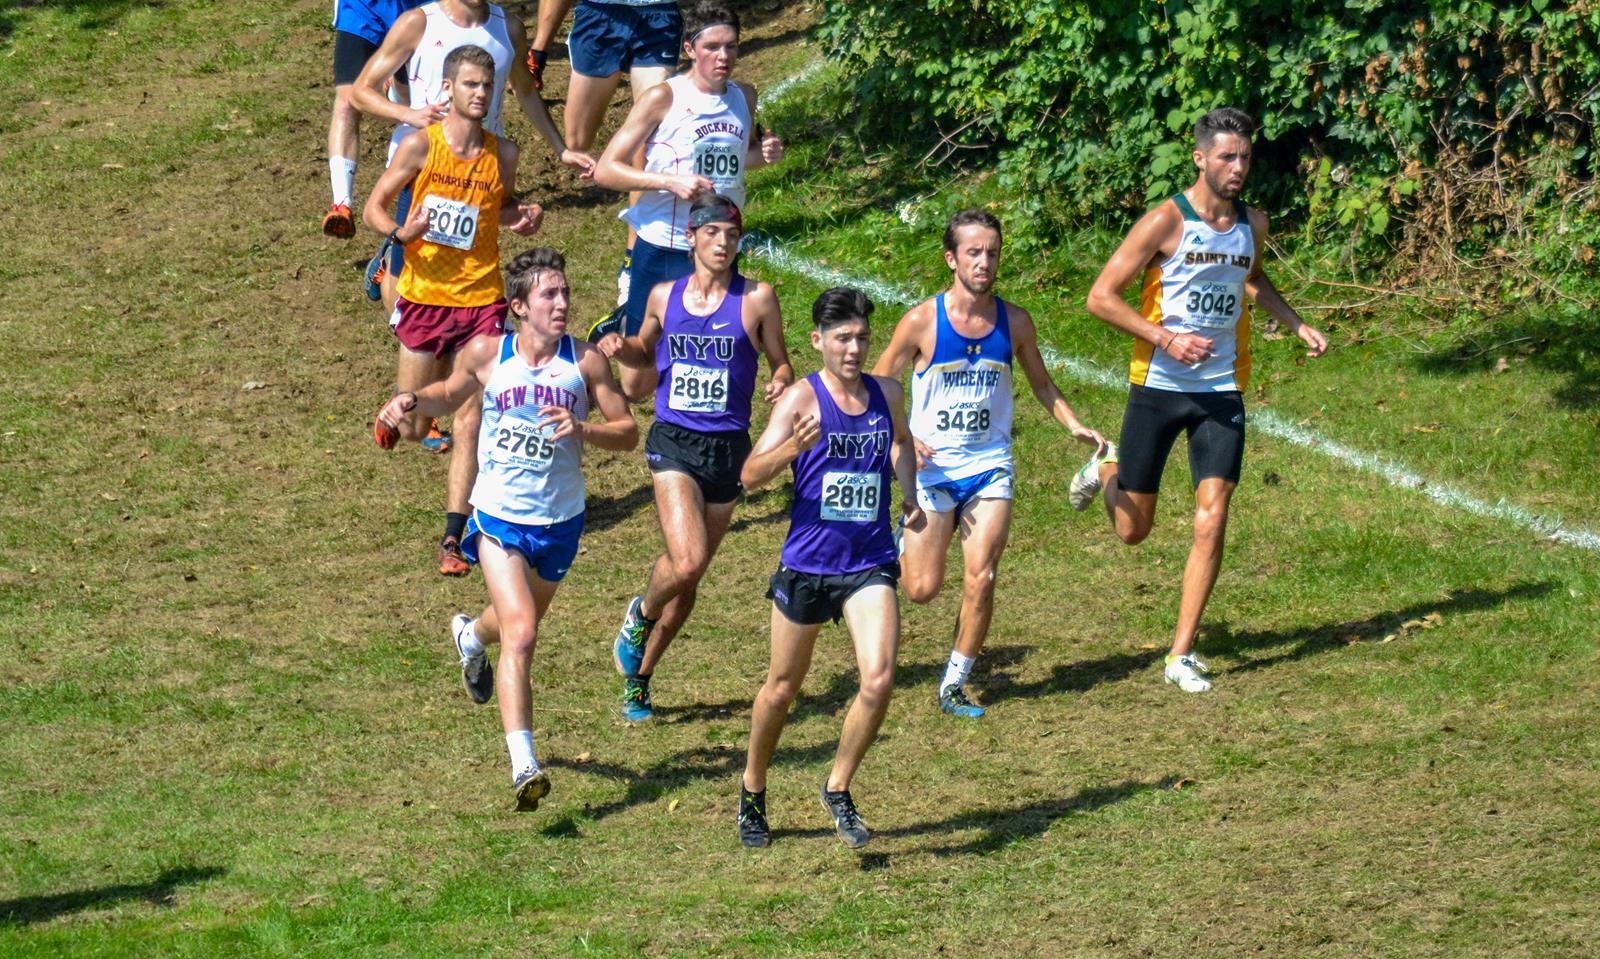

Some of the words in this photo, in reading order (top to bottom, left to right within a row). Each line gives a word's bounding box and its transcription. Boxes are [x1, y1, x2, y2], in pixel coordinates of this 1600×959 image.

[695, 122, 744, 140] BUCKNELL
[696, 154, 739, 176] 1909
[431, 172, 491, 192] CHARLESTON
[429, 208, 474, 238] 2010
[1185, 252, 1227, 265] SAINT
[1186, 291, 1236, 316] 3042
[668, 334, 735, 361] NYU
[496, 385, 527, 412] NEW
[674, 377, 725, 400] 2816
[936, 409, 990, 432] 3428
[496, 428, 554, 460] 2765
[826, 430, 889, 459] NYU
[824, 485, 877, 508] 2818
